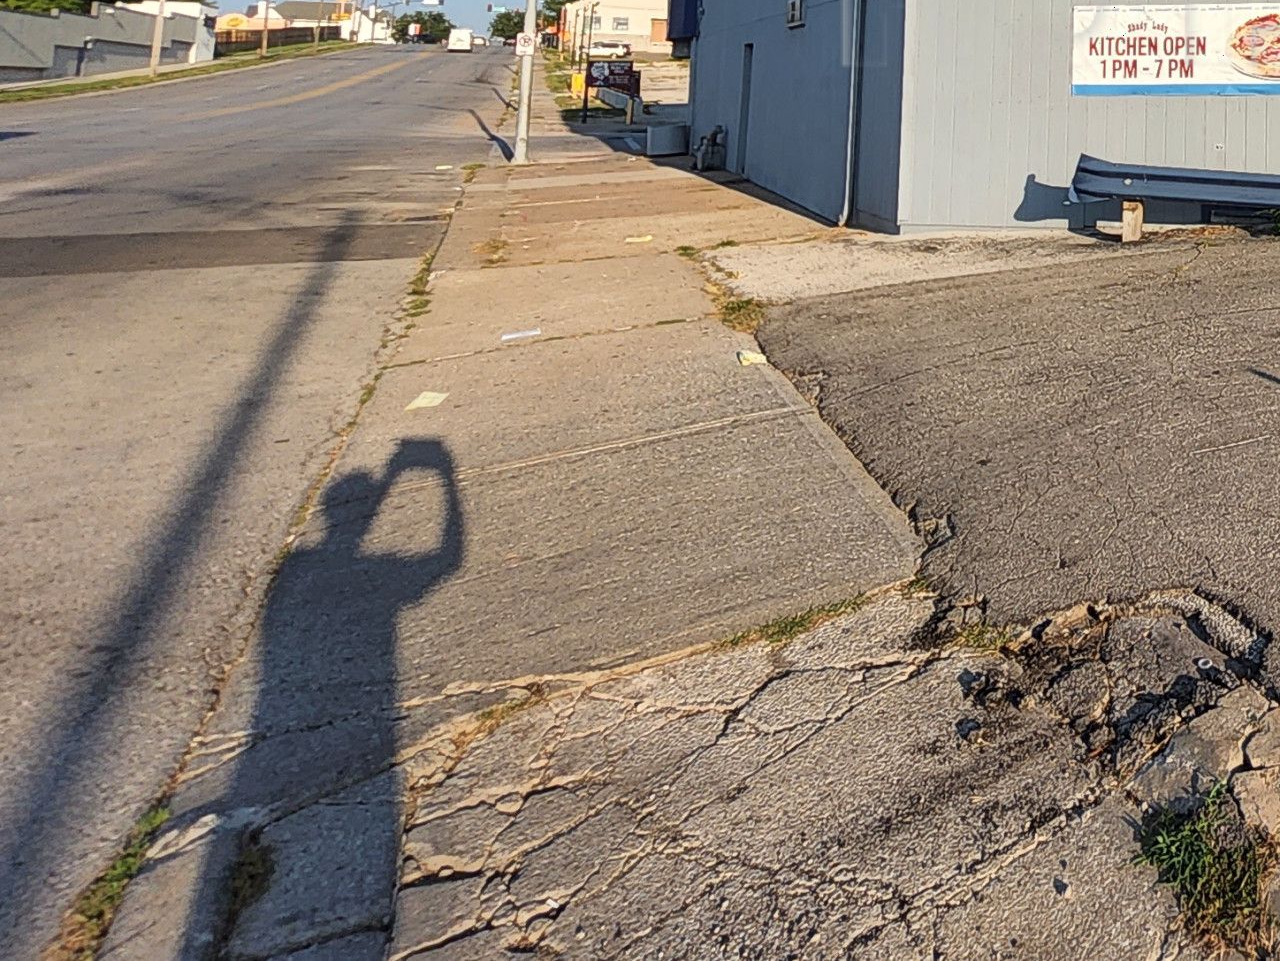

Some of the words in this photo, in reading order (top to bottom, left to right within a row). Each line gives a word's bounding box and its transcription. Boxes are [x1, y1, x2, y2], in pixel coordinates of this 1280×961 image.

[1127, 21, 1147, 33] Shady
[1152, 21, 1168, 34] Lady
[1089, 36, 1158, 56] KITCHEN
[1163, 36, 1207, 56] OPEN
